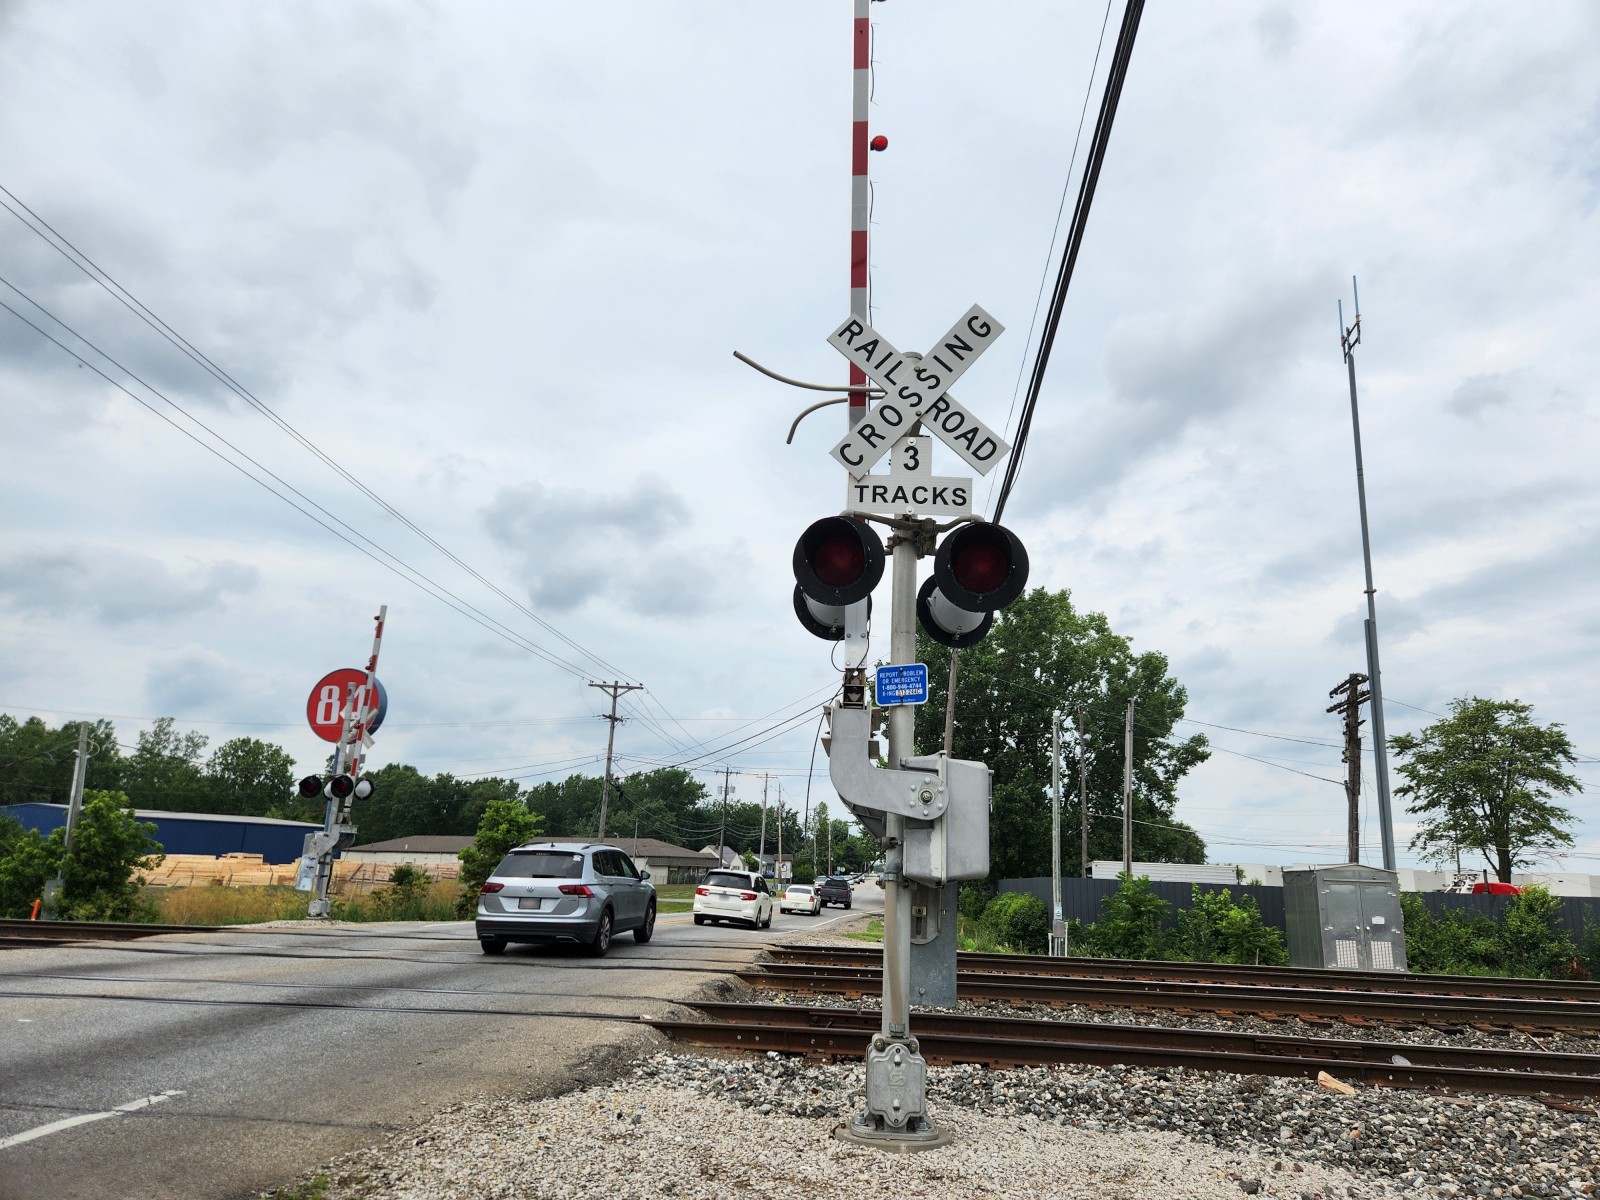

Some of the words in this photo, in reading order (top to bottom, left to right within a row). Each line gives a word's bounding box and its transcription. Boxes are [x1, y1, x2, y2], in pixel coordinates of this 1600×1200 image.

[837, 319, 904, 386] RAIL
[925, 395, 998, 462] ROAD
[839, 315, 992, 467] CROSSING
[854, 484, 968, 506] TRACKS
[903, 445, 920, 471] 3
